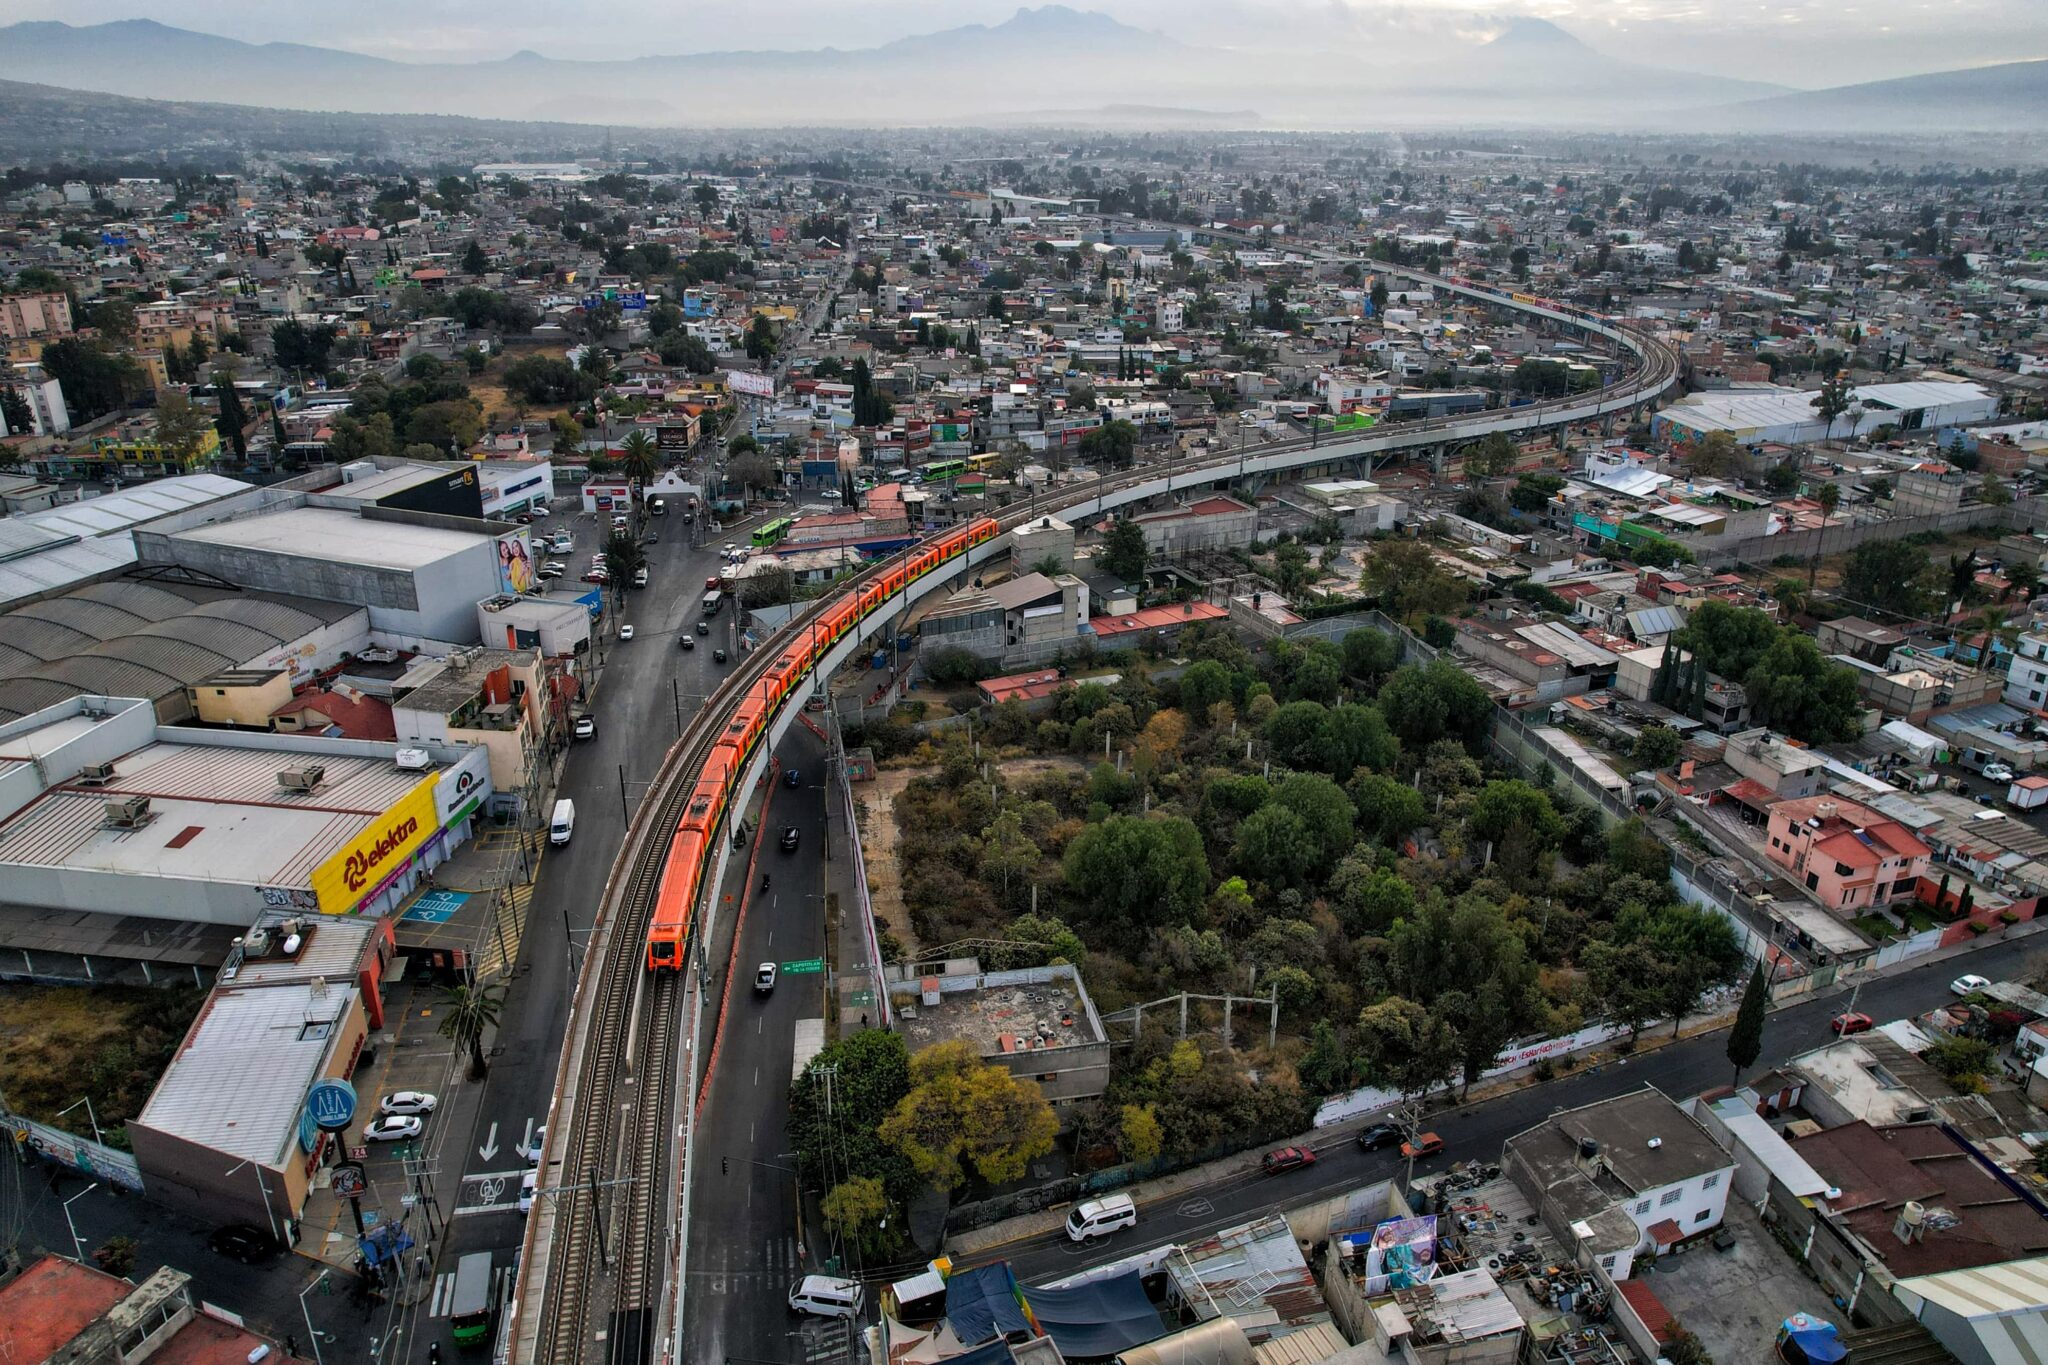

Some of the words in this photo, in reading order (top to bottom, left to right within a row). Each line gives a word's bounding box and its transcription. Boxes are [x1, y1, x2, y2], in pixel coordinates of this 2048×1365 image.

[448, 476, 464, 488] smart
[465, 777, 485, 799] Azteca
[368, 816, 418, 867] elektra
[354, 1148, 366, 1156] 24
